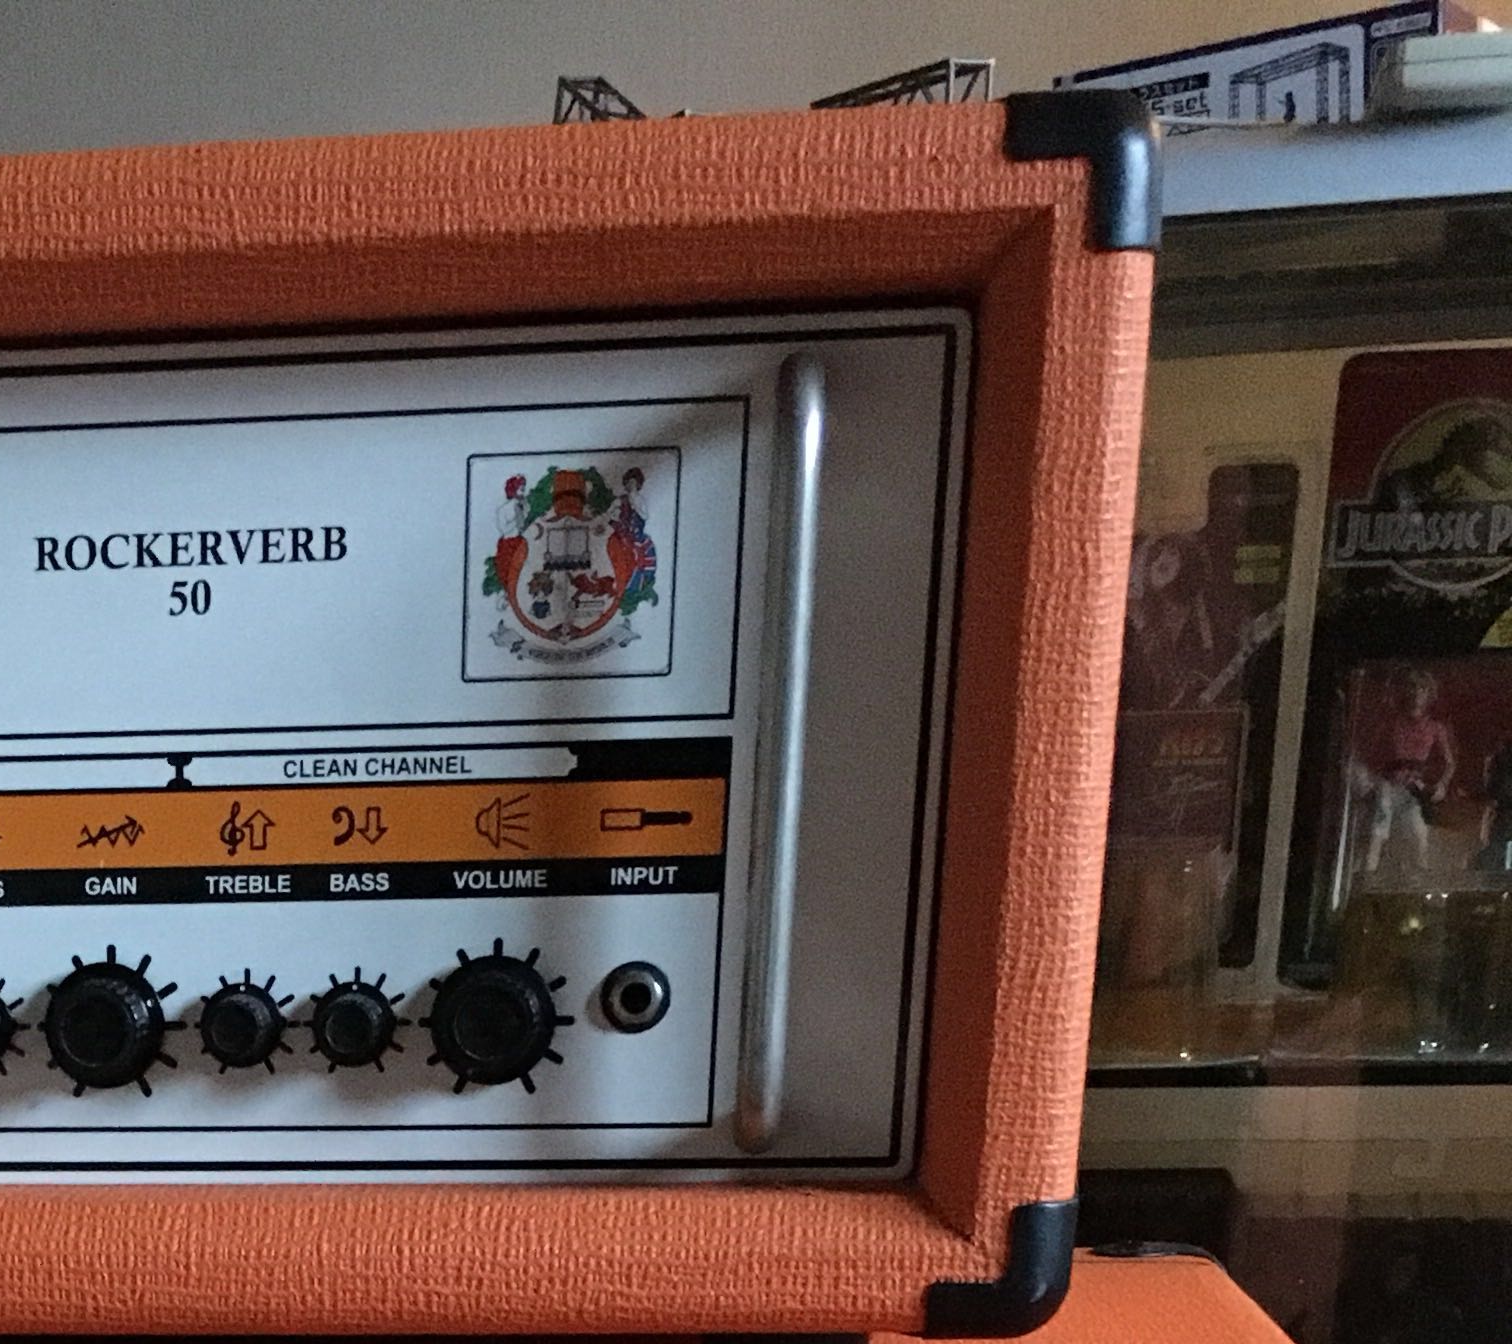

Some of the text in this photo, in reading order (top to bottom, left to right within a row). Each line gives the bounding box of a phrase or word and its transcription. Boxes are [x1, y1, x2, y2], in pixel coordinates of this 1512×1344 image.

[1340, 510, 1483, 558] JURASSIC
[35, 526, 348, 572] ROCKERVERB
[169, 579, 212, 617] 50
[283, 755, 473, 778] CLEAN CHANNEL
[84, 876, 137, 896] GAIN
[205, 874, 291, 895] TREBLE
[329, 872, 390, 893] BASS
[452, 869, 547, 889] VOLUME
[610, 866, 679, 886] INPUT
